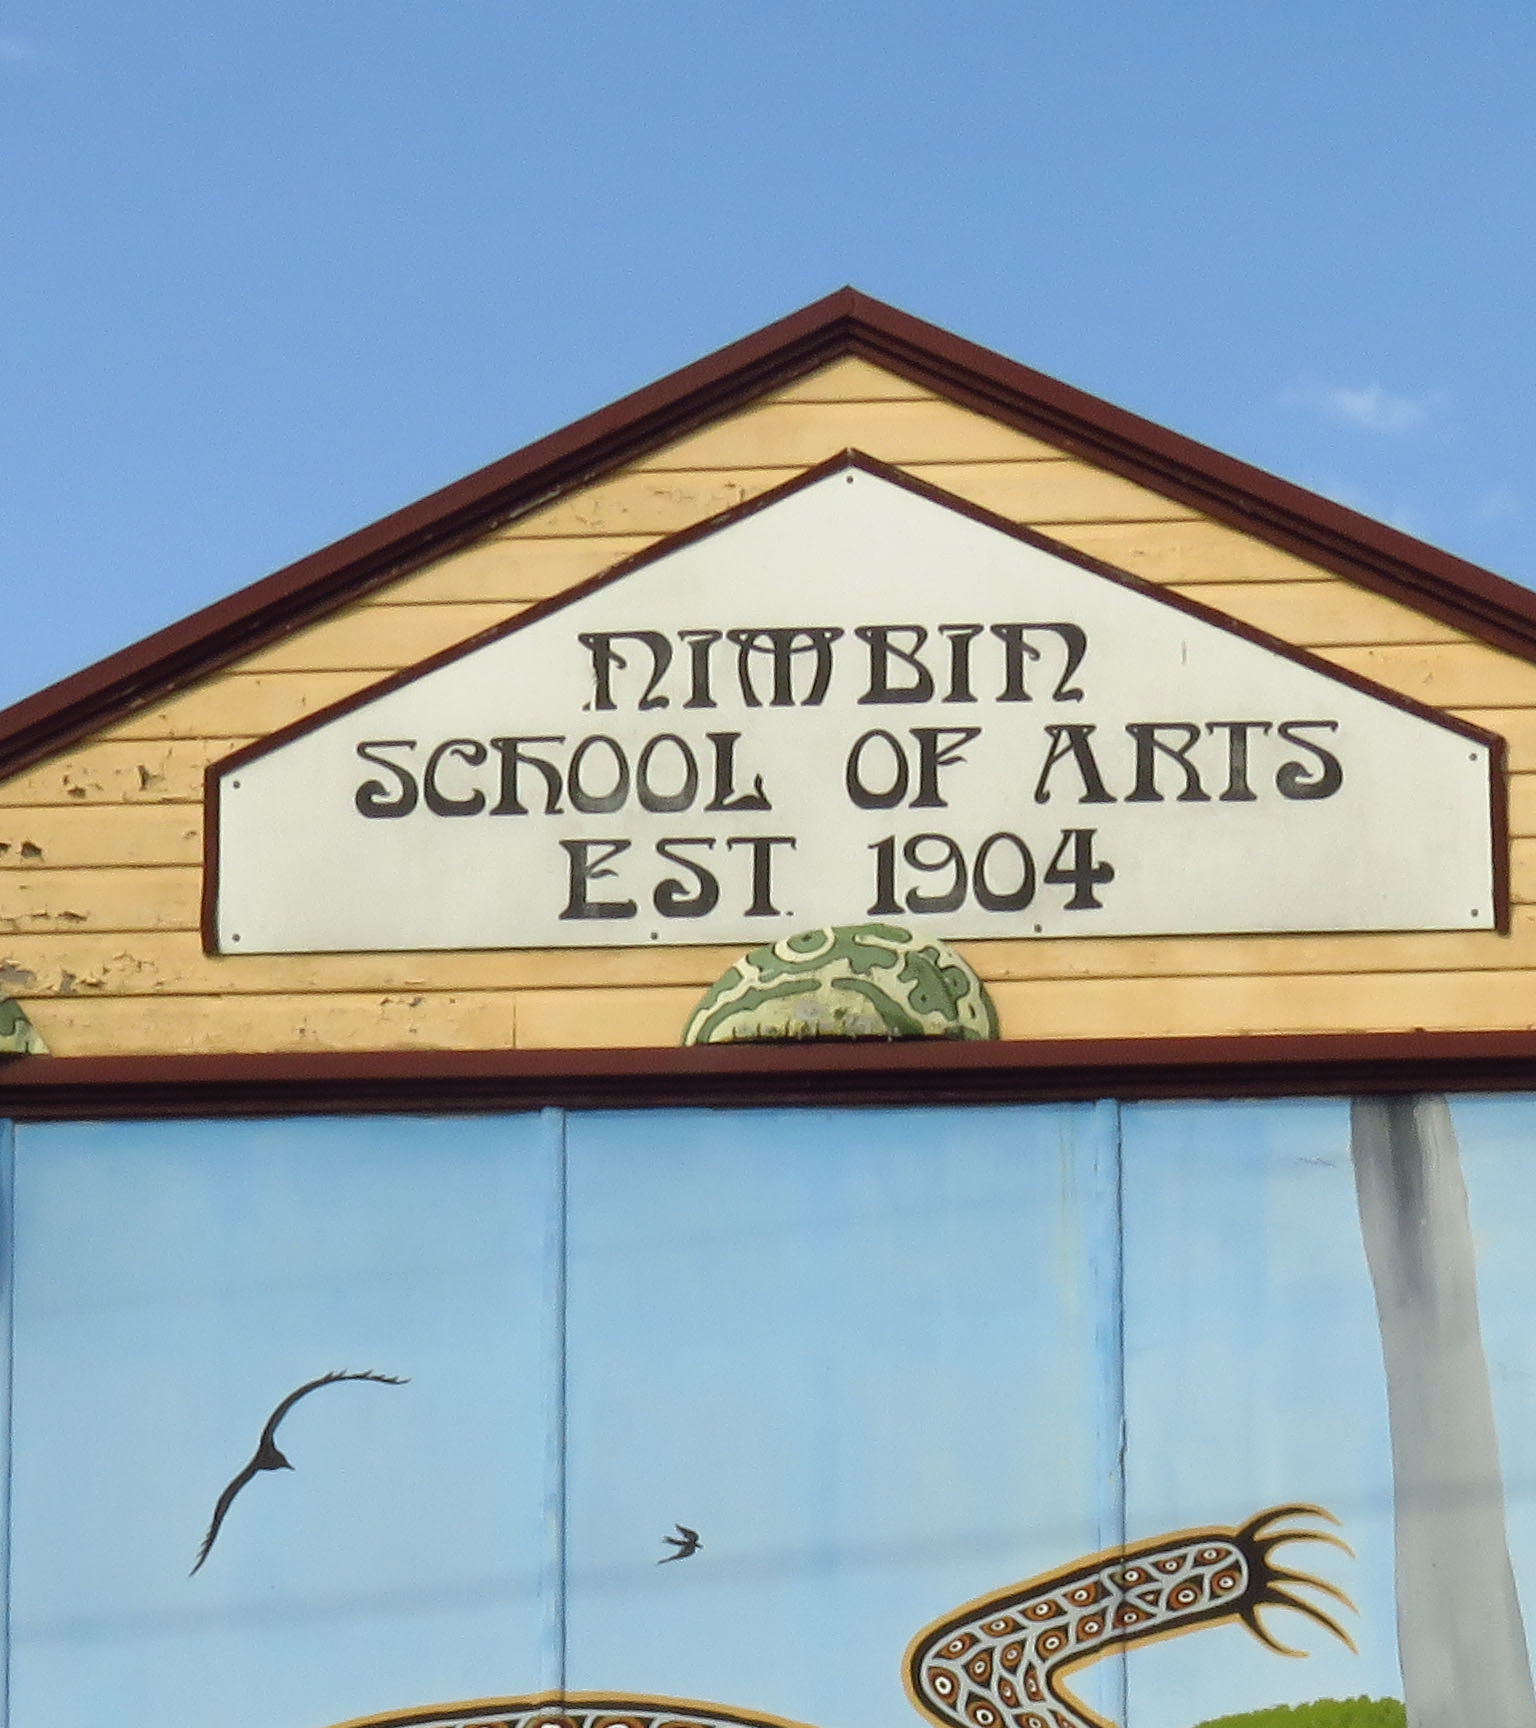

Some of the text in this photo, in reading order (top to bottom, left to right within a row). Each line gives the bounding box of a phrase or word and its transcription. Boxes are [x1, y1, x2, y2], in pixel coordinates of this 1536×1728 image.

[578, 621, 1088, 711] NIMBIN
[355, 719, 1344, 819] SCHOOL OF ARTS
[866, 828, 1116, 917] 1904
